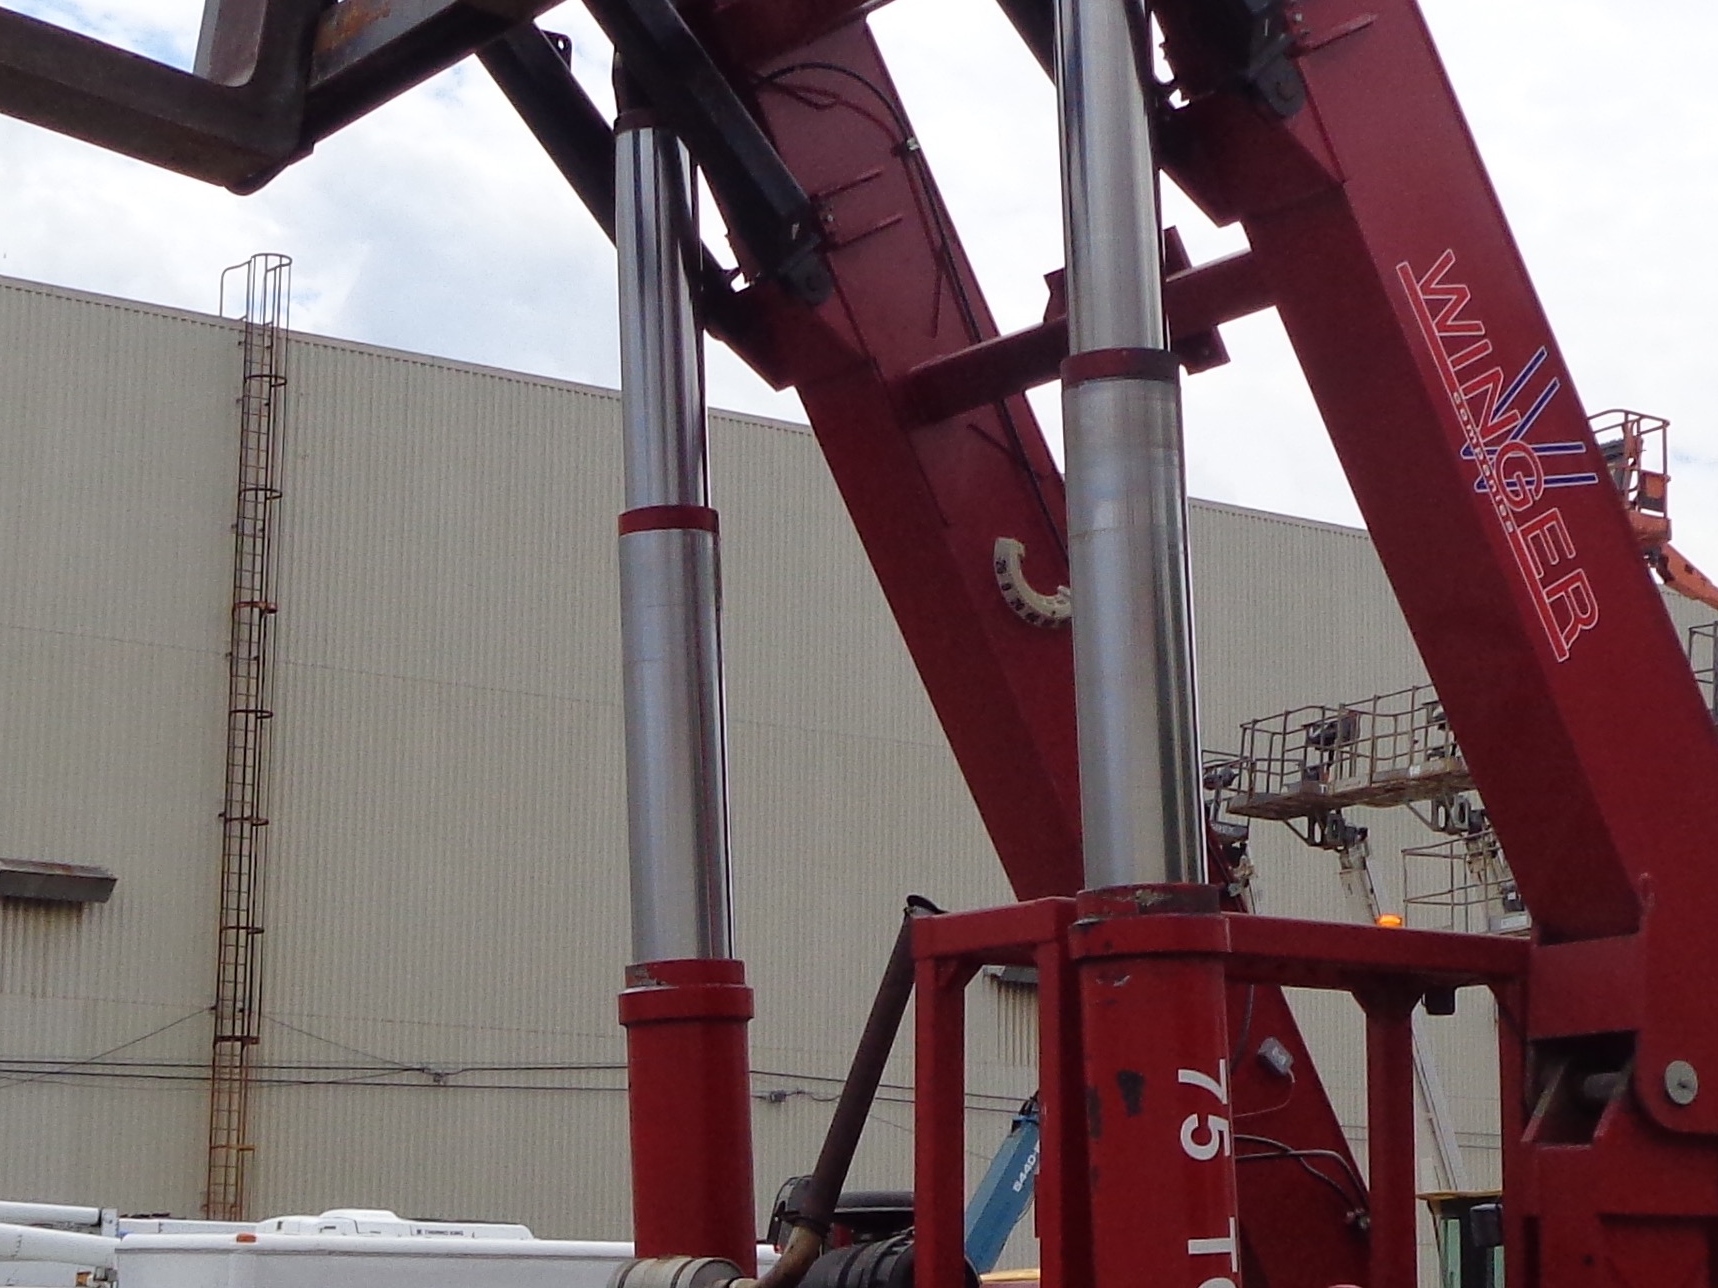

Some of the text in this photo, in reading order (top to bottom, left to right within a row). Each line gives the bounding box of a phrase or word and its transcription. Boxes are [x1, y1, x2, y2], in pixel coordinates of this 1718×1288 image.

[1417, 248, 1601, 650] WINGER
[1451, 389, 1517, 535] companies
[1177, 1058, 1232, 1161] 75
